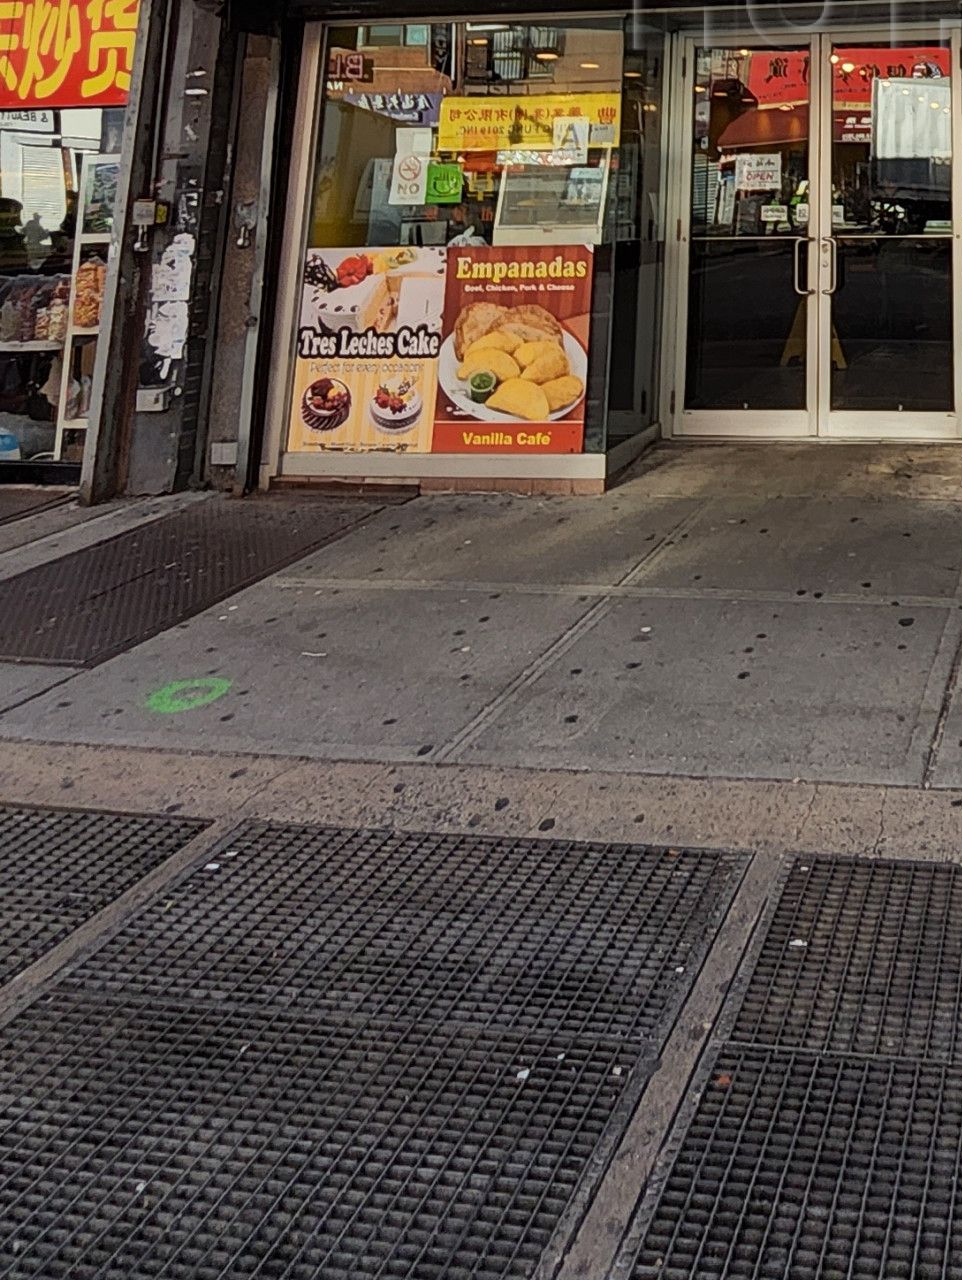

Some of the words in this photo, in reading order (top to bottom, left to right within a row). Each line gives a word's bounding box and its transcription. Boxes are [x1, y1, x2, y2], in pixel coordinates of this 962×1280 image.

[745, 172, 774, 182] OPEN
[456, 256, 588, 283] Empanadas
[301, 328, 338, 356] Tres
[338, 328, 395, 356] Leches
[396, 328, 440, 356] Cake
[463, 431, 513, 445] Vanilla
